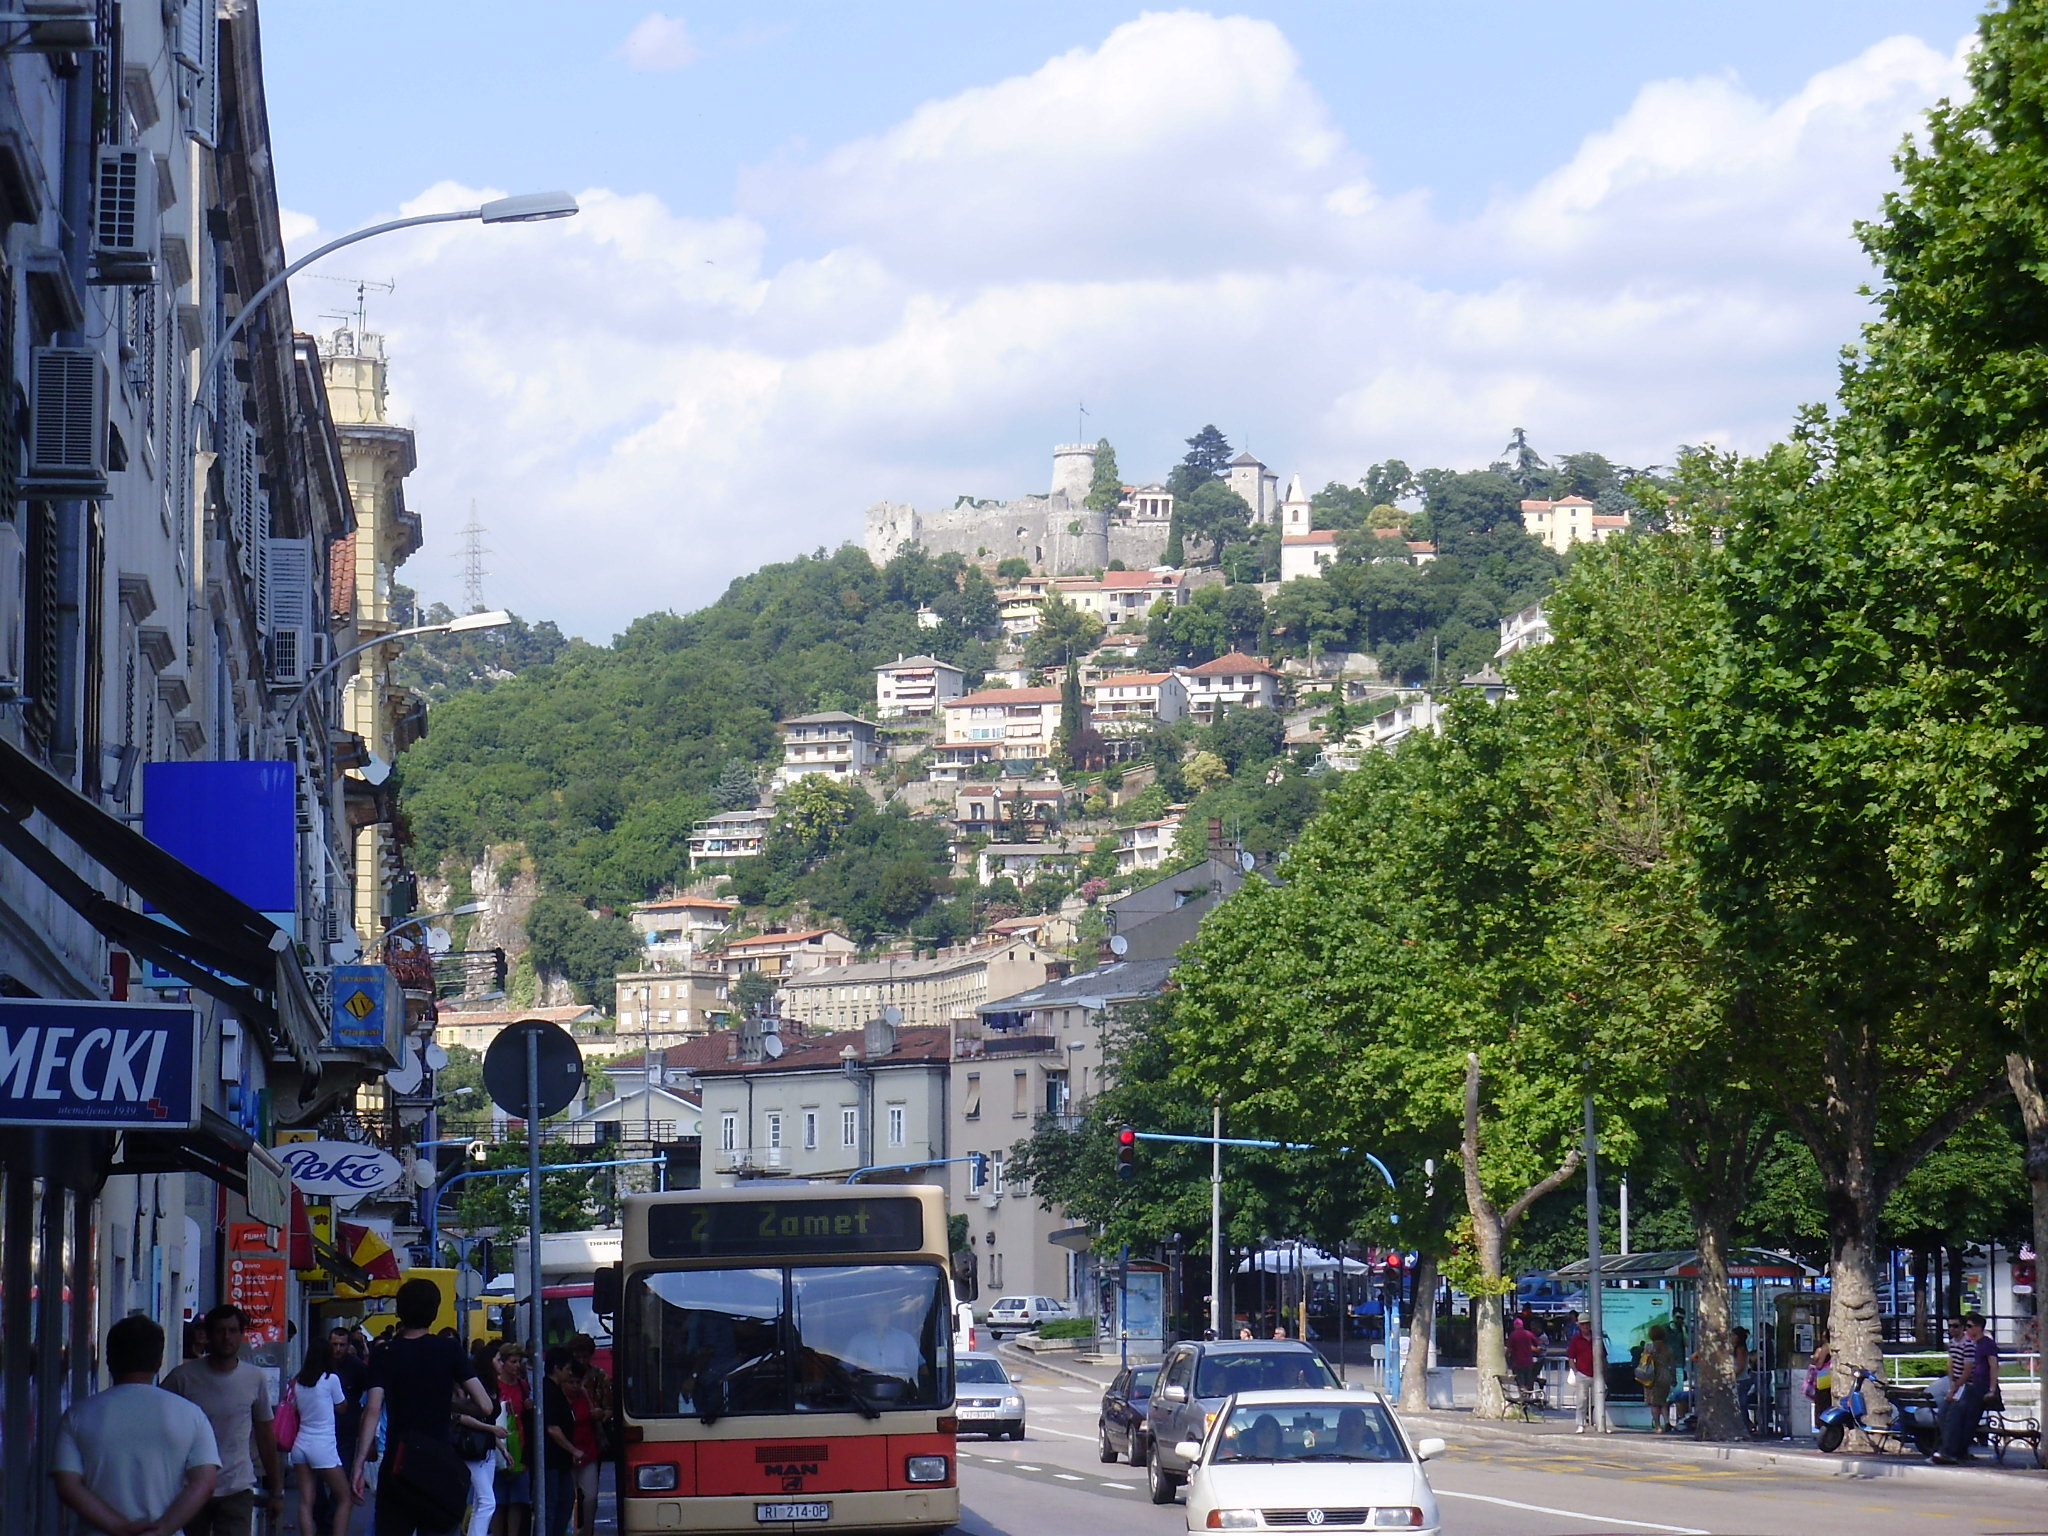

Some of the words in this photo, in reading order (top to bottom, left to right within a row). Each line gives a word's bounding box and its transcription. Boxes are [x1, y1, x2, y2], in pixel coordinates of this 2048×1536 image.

[58, 1105, 110, 1117] utemeljeno
[691, 1206, 710, 1240] 2
[758, 1202, 870, 1237] Zamet
[765, 1464, 818, 1476] MAN
[765, 1507, 777, 1518] RI
